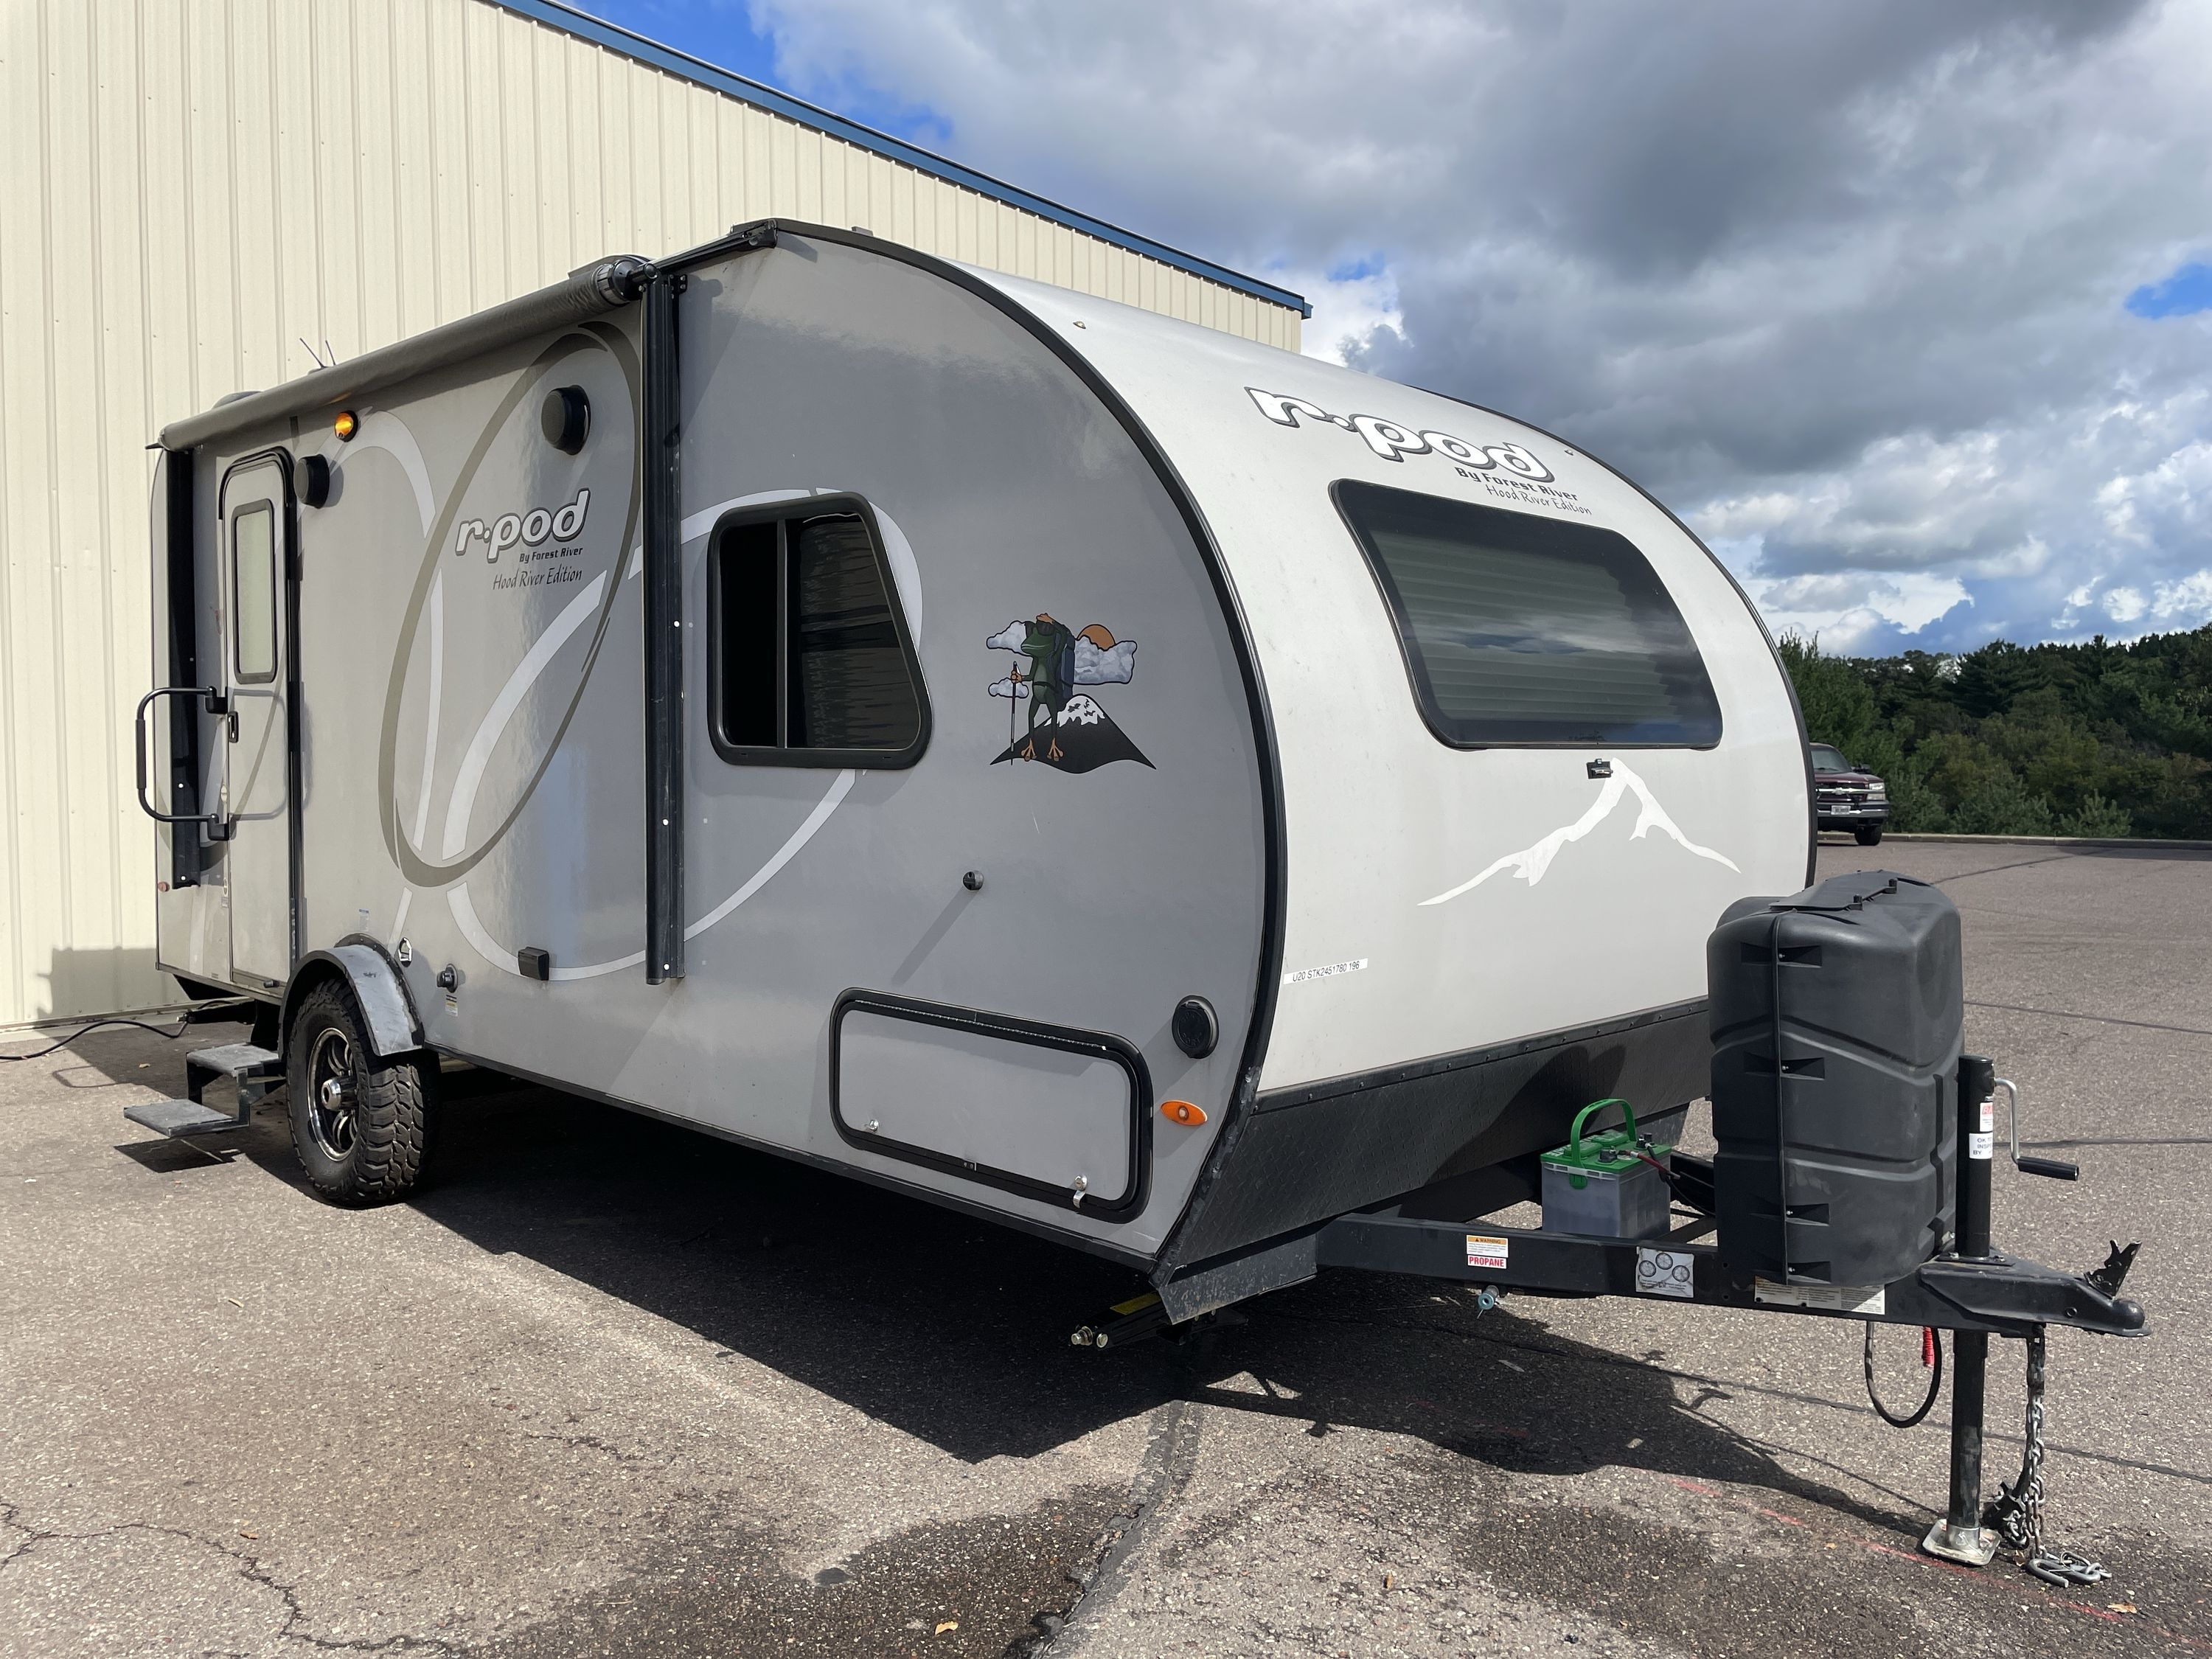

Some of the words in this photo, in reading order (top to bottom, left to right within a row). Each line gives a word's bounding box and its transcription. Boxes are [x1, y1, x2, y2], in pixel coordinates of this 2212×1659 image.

[1455, 467, 1481, 483] By
[1482, 473, 1537, 492] Forest
[1538, 484, 1578, 501] River
[1485, 484, 1519, 501] Hood
[1519, 490, 1550, 507] River
[1551, 498, 1592, 515] Edition
[519, 553, 529, 563] By
[532, 549, 558, 560] Forest
[560, 547, 583, 557] River
[493, 568, 519, 590] Hood
[519, 571, 545, 587] River
[546, 563, 582, 584] Edition
[1293, 971, 1306, 981] U20
[1307, 963, 1347, 978] STK2451780
[1349, 961, 1360, 970] 196
[1469, 1256, 1504, 1267] PROPANE
